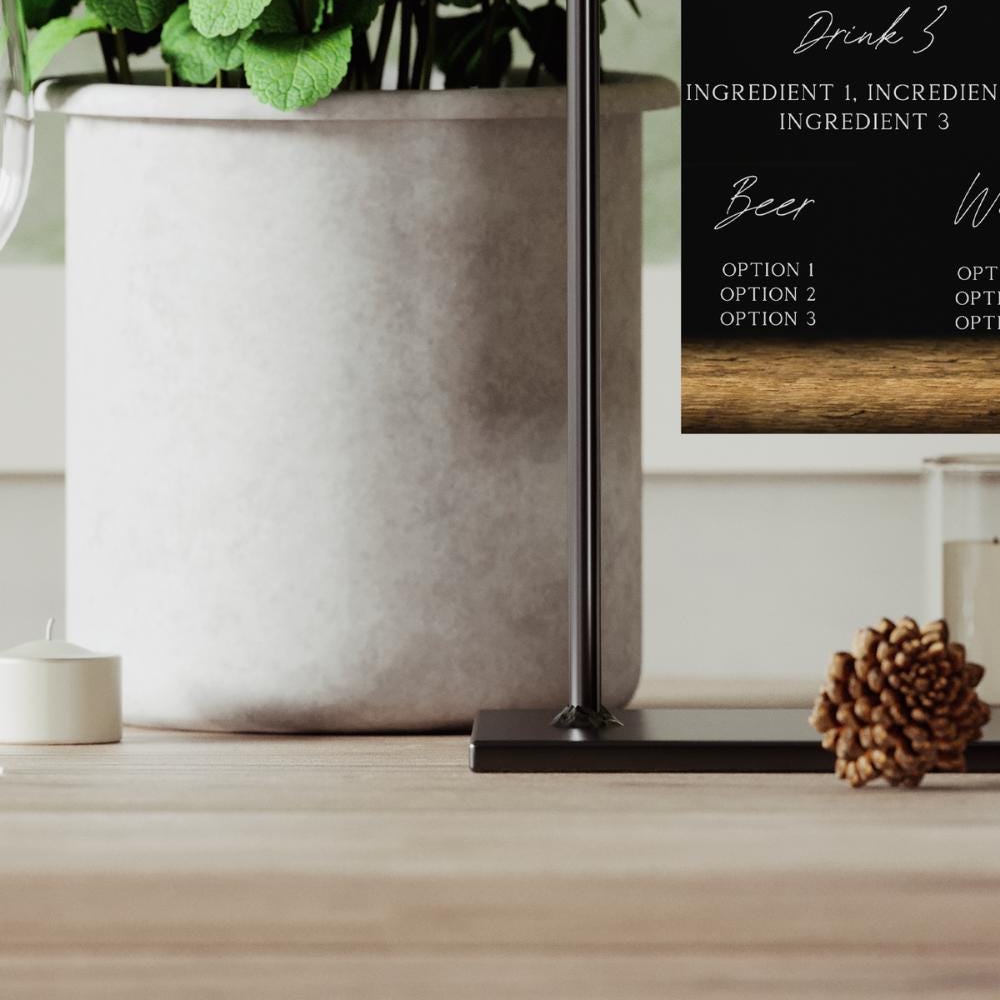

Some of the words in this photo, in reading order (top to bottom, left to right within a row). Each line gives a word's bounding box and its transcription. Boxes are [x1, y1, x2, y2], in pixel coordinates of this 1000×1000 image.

[793, 7, 911, 54] Drink
[913, 5, 947, 53] 3
[685, 83, 835, 102] INGREDIENT
[844, 84, 857, 103] 1,
[779, 112, 928, 131] INGREDIENT
[938, 112, 950, 131] 3
[714, 176, 815, 230] Beer
[721, 261, 800, 278] OPTION
[720, 286, 798, 302] OPTION
[806, 286, 816, 302] 2
[719, 311, 798, 327] OPTION
[806, 310, 816, 327] 3
